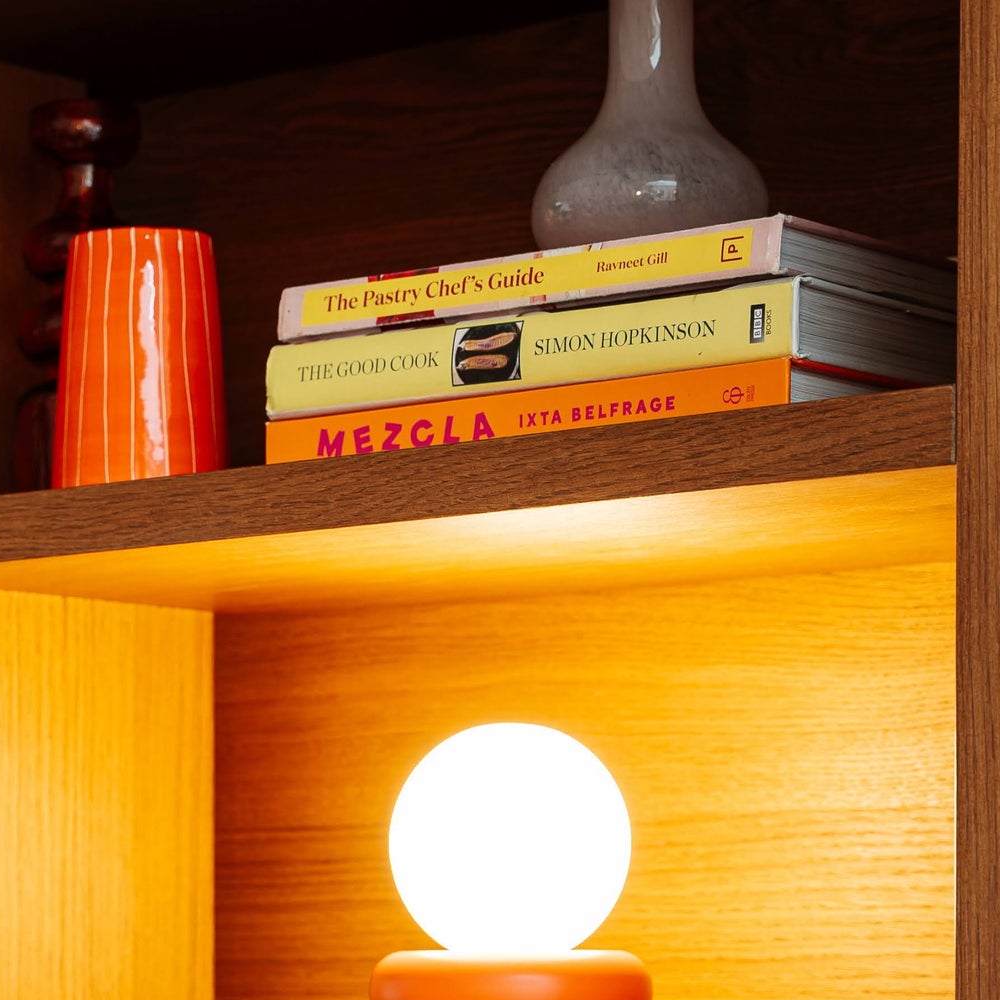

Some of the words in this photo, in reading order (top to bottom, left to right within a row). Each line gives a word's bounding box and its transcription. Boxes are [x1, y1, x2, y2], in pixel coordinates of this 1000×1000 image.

[597, 257, 645, 272] Ravneet
[647, 252, 668, 265] Gill
[324, 293, 358, 312] The
[363, 287, 421, 307] Pastry
[426, 275, 483, 298] Chef's
[488, 266, 545, 289] Guide
[534, 333, 596, 356] SIMON
[600, 320, 716, 348] HOPKINSON
[298, 363, 333, 382] THE
[336, 357, 386, 378] GOOD
[390, 351, 439, 372] COOK
[519, 409, 562, 428] IXTA
[572, 396, 675, 422] BELFRAGE
[317, 412, 495, 458] MEZCLA
